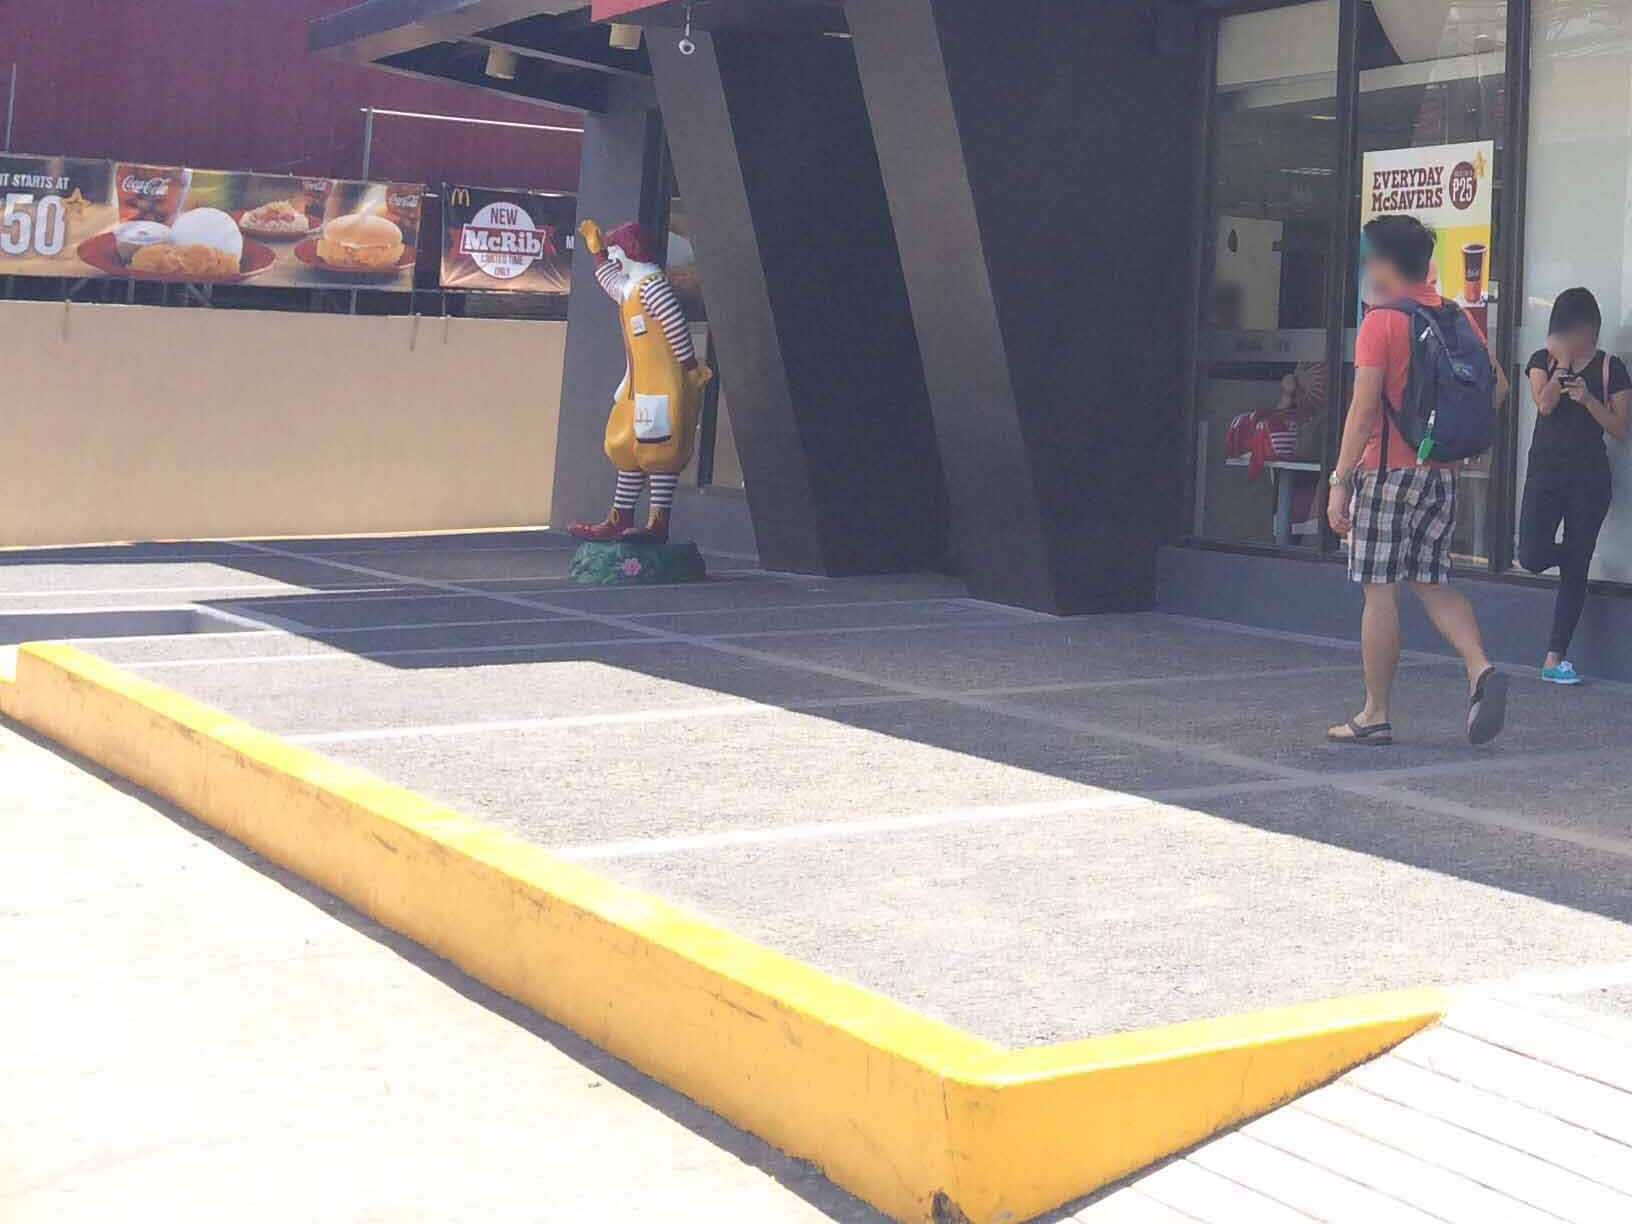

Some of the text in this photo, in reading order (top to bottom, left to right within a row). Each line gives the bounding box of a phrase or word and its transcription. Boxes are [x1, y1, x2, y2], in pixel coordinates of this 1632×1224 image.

[12, 173, 54, 189] STARTS
[56, 176, 71, 190] AT
[1373, 166, 1444, 190] EVERYDAY
[1372, 188, 1444, 212] McSAVERS
[489, 207, 518, 225] NEW
[464, 230, 541, 253] McRib
